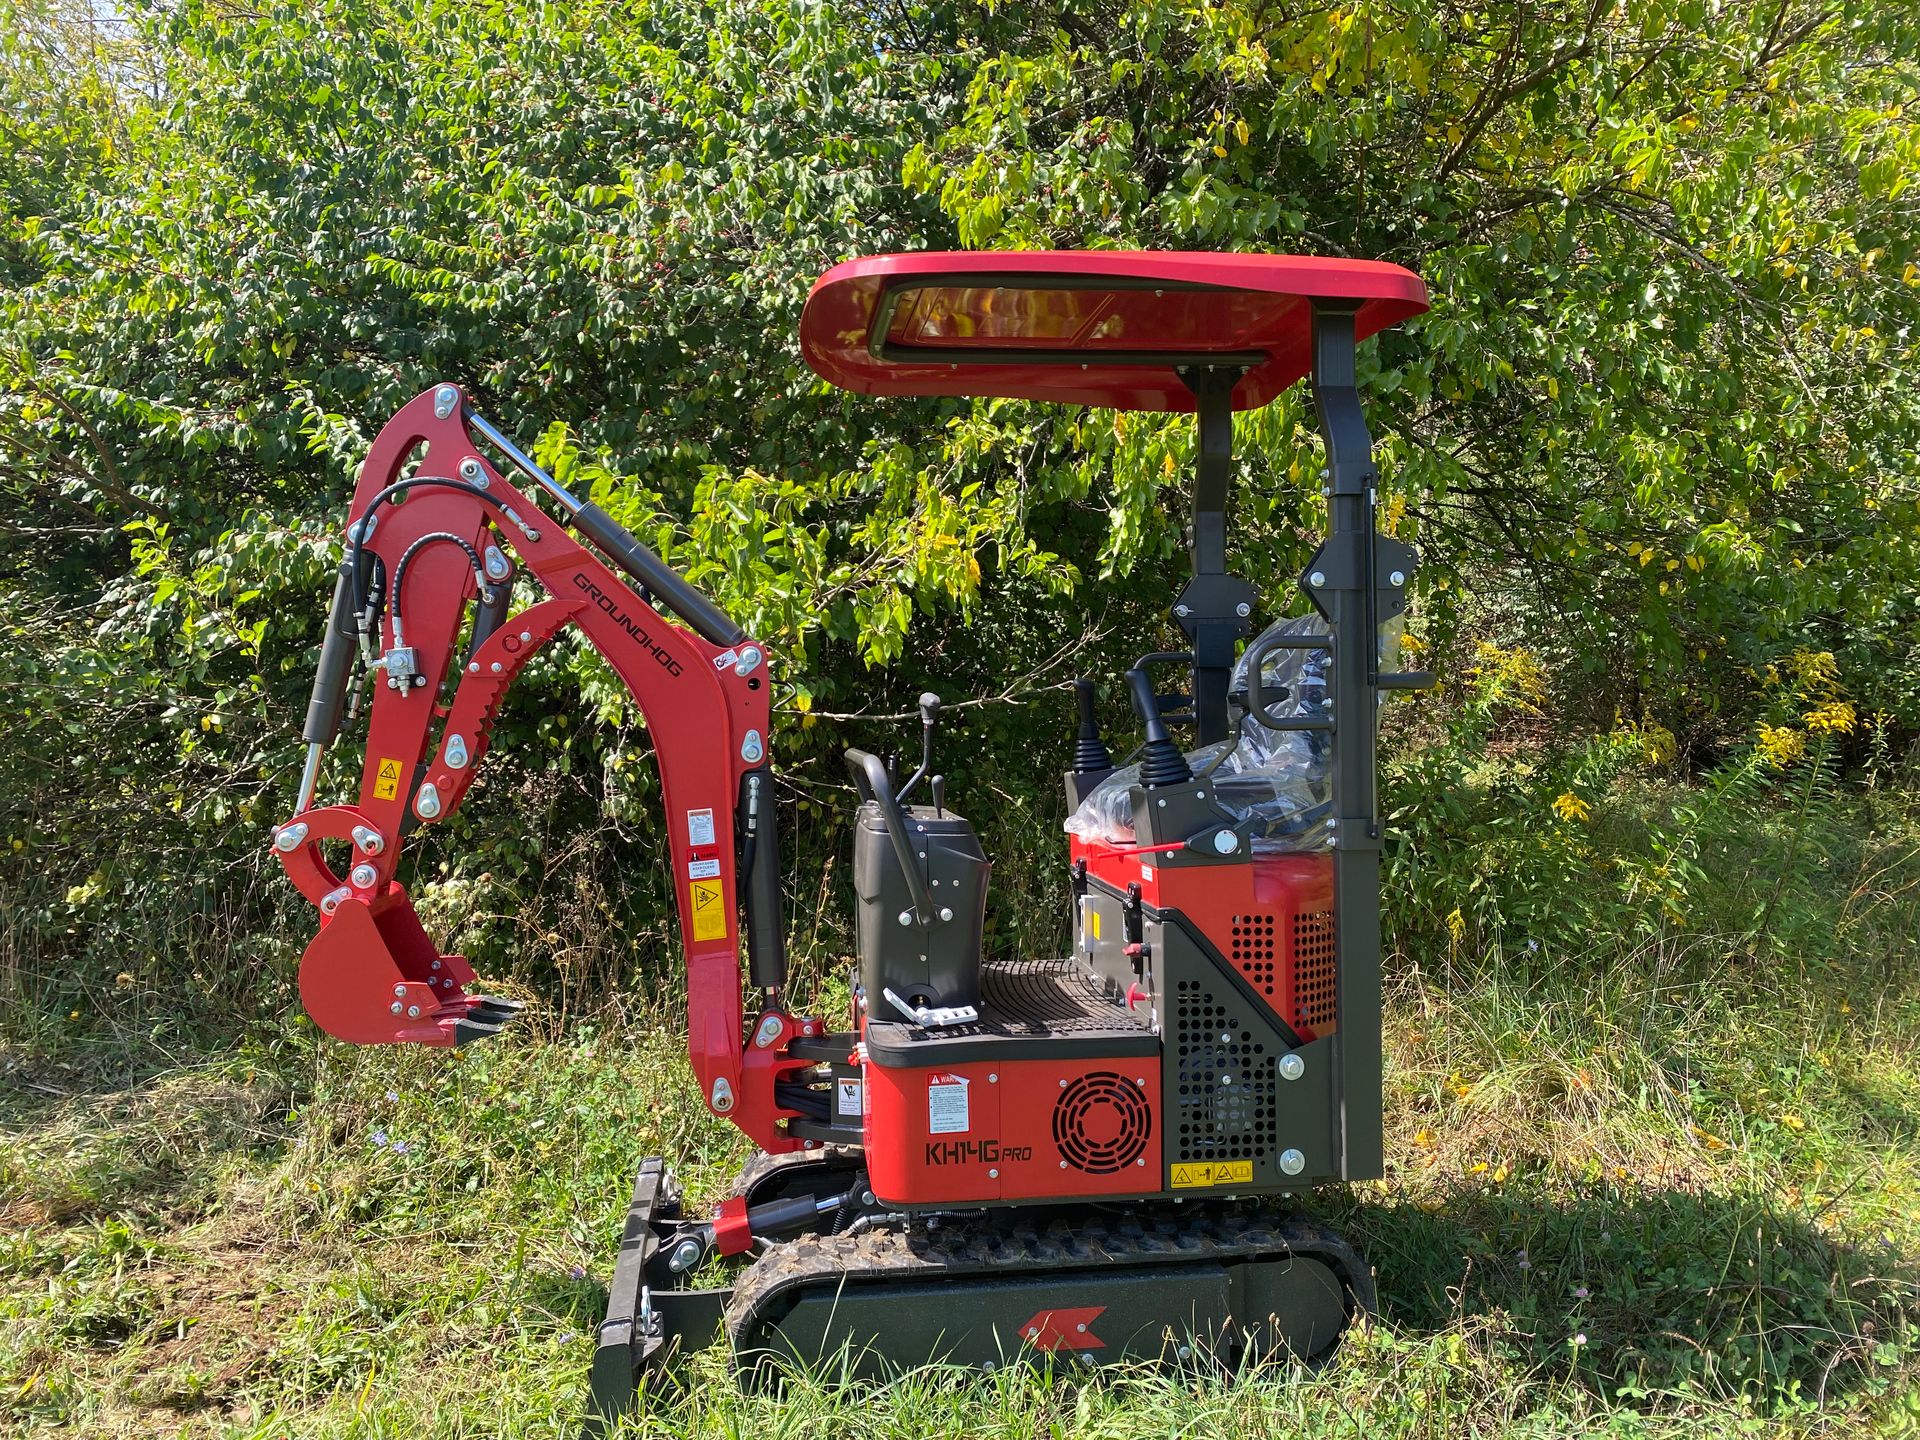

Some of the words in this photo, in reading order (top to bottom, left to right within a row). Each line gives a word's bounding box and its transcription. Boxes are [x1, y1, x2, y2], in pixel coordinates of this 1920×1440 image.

[573, 573, 684, 677] GROUNDHOG
[925, 1140, 999, 1165] KH14G
[1002, 1147, 1032, 1162] PRO
